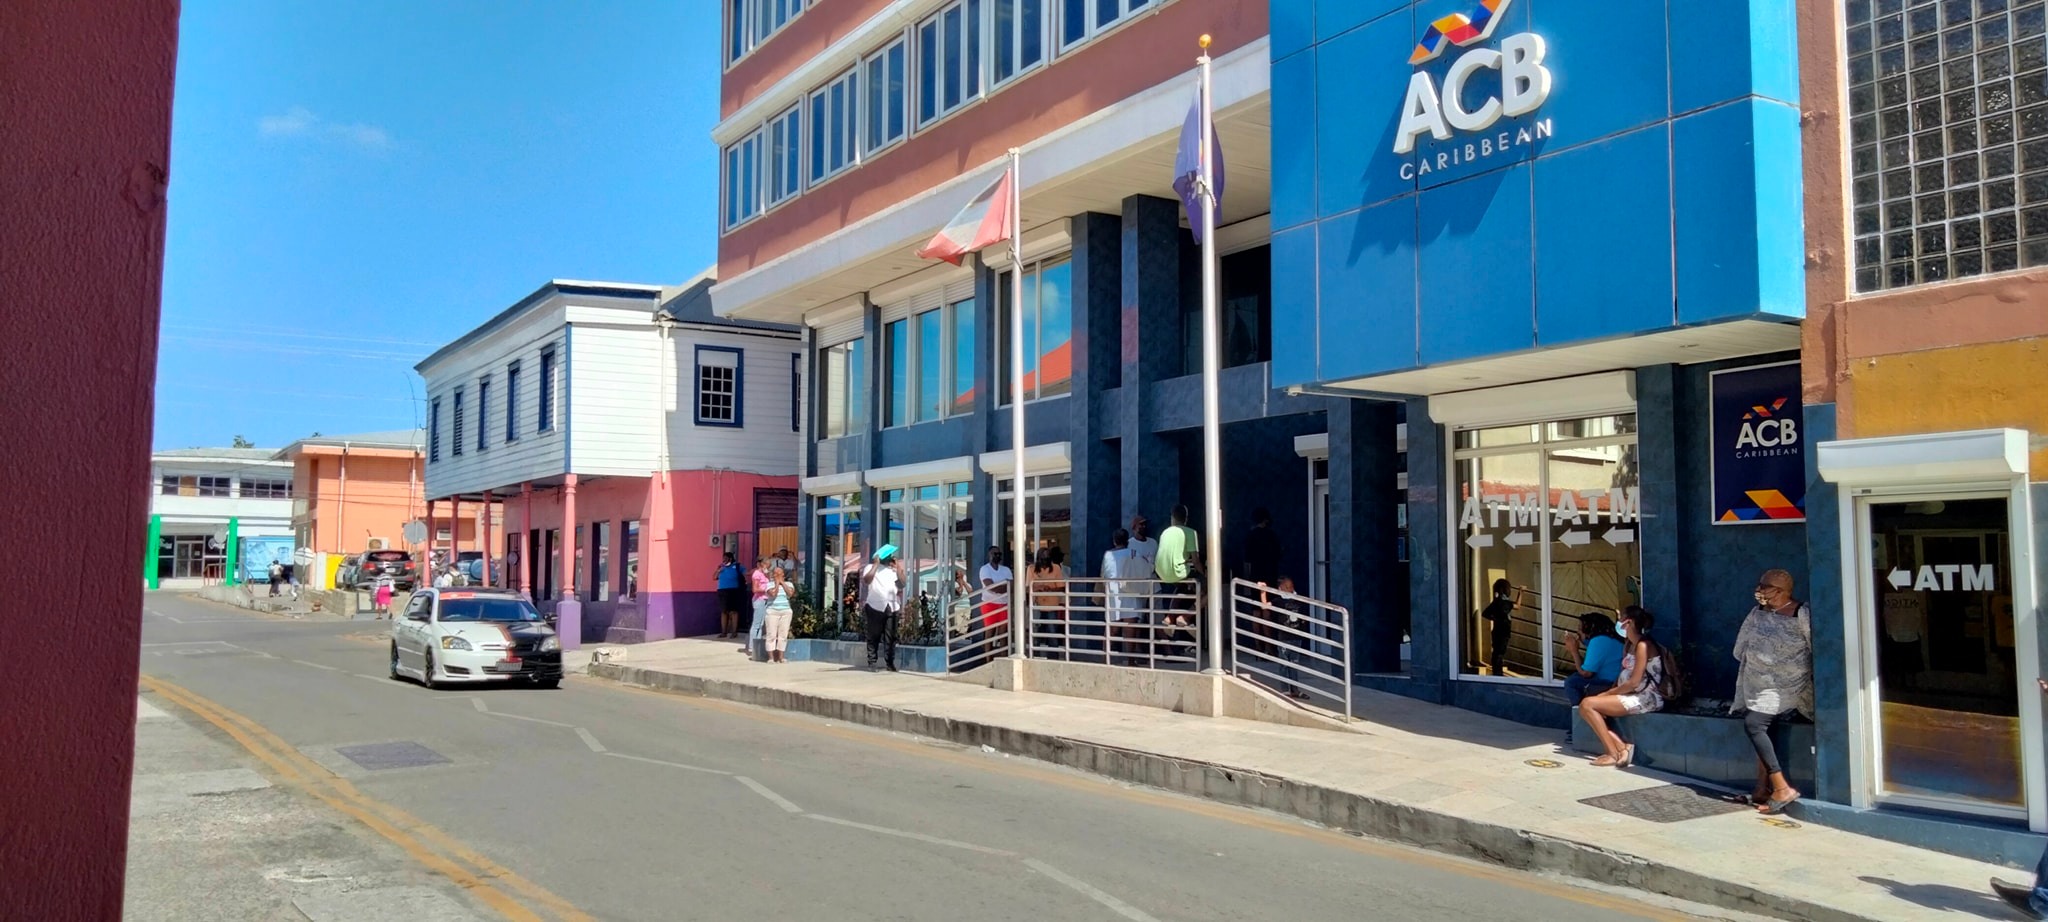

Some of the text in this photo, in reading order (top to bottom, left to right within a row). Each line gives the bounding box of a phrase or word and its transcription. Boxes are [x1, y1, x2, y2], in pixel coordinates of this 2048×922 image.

[1392, 32, 1552, 154] ACB
[1399, 118, 1553, 181] CARIBBEAN
[1735, 418, 1798, 449] ACB
[1735, 447, 1798, 459] CARIBBEAN
[1459, 486, 1640, 530] ATM ATM
[1913, 564, 1995, 592] ATM
